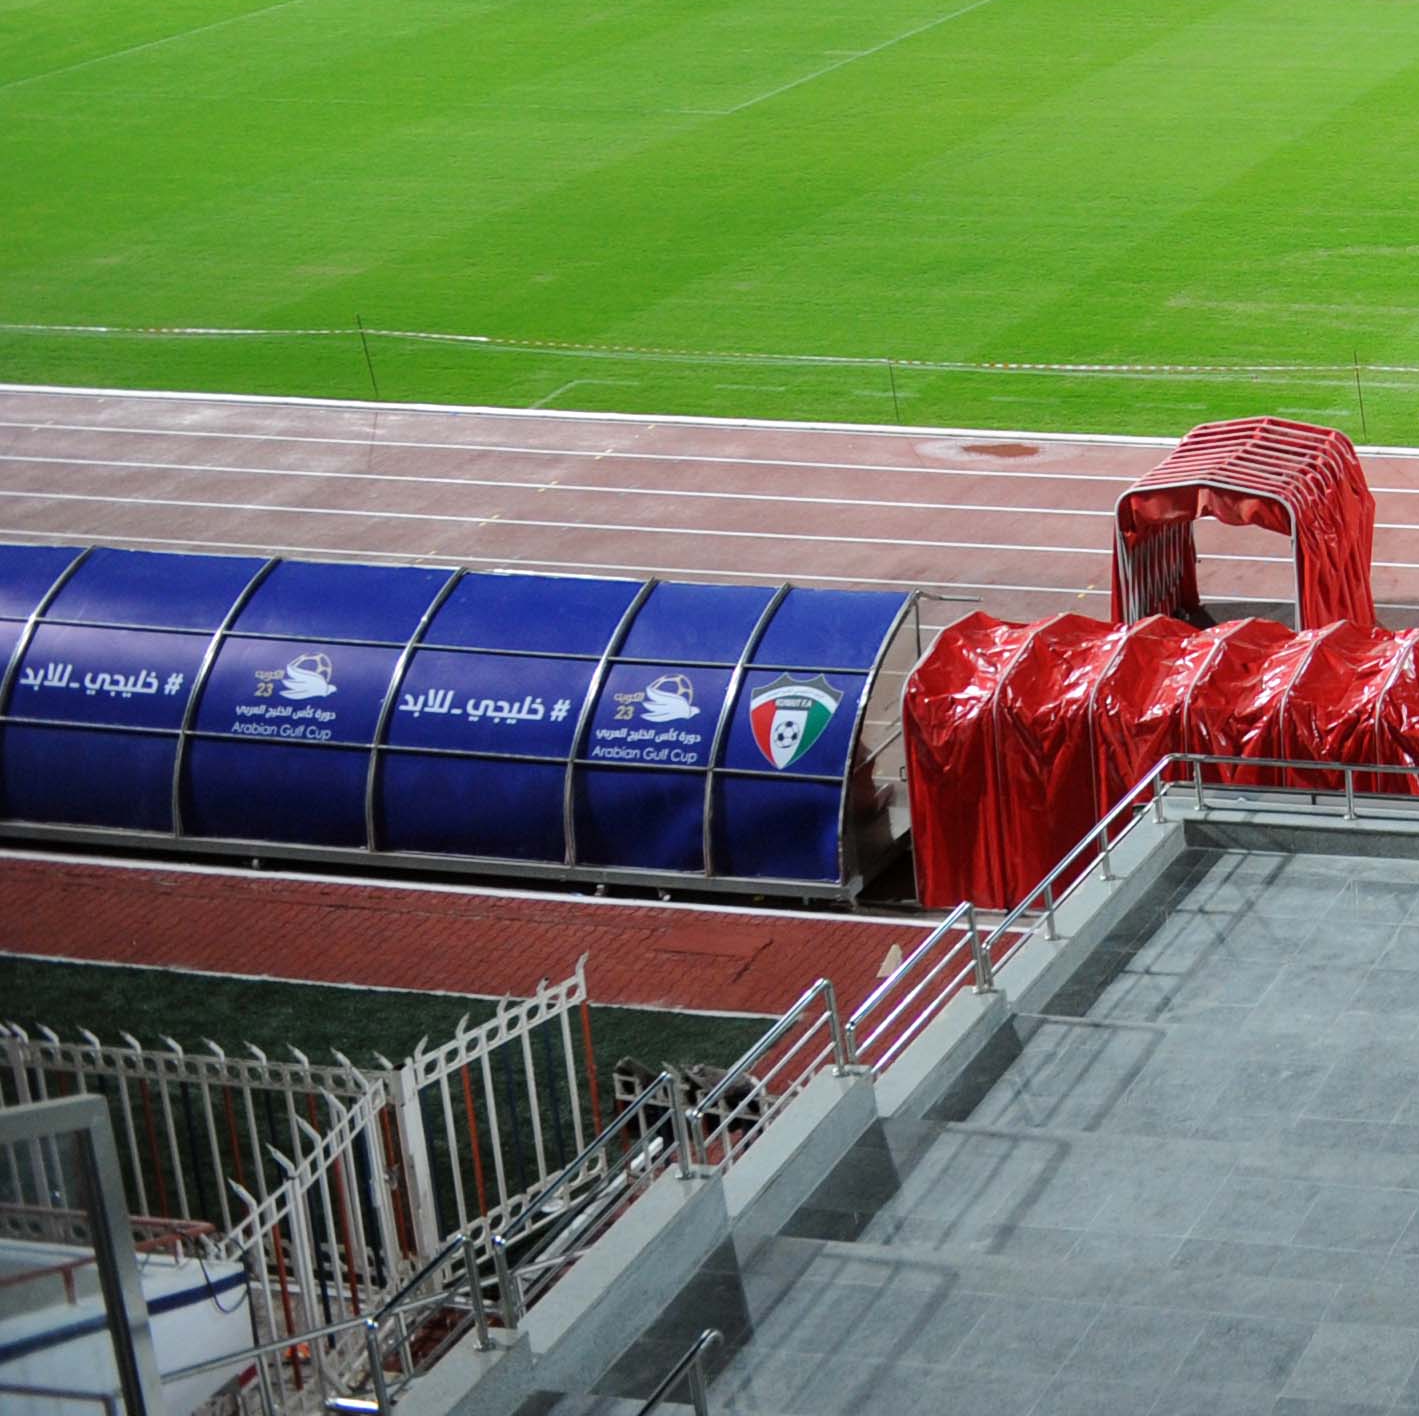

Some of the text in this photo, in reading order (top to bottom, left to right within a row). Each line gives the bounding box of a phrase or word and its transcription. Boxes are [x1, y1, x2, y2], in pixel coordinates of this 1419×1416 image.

[254, 682, 274, 697] 23
[613, 705, 635, 721] 23
[231, 720, 332, 741] Arabian Gulf Cup
[591, 745, 697, 765] Arabian Gulf Cup
